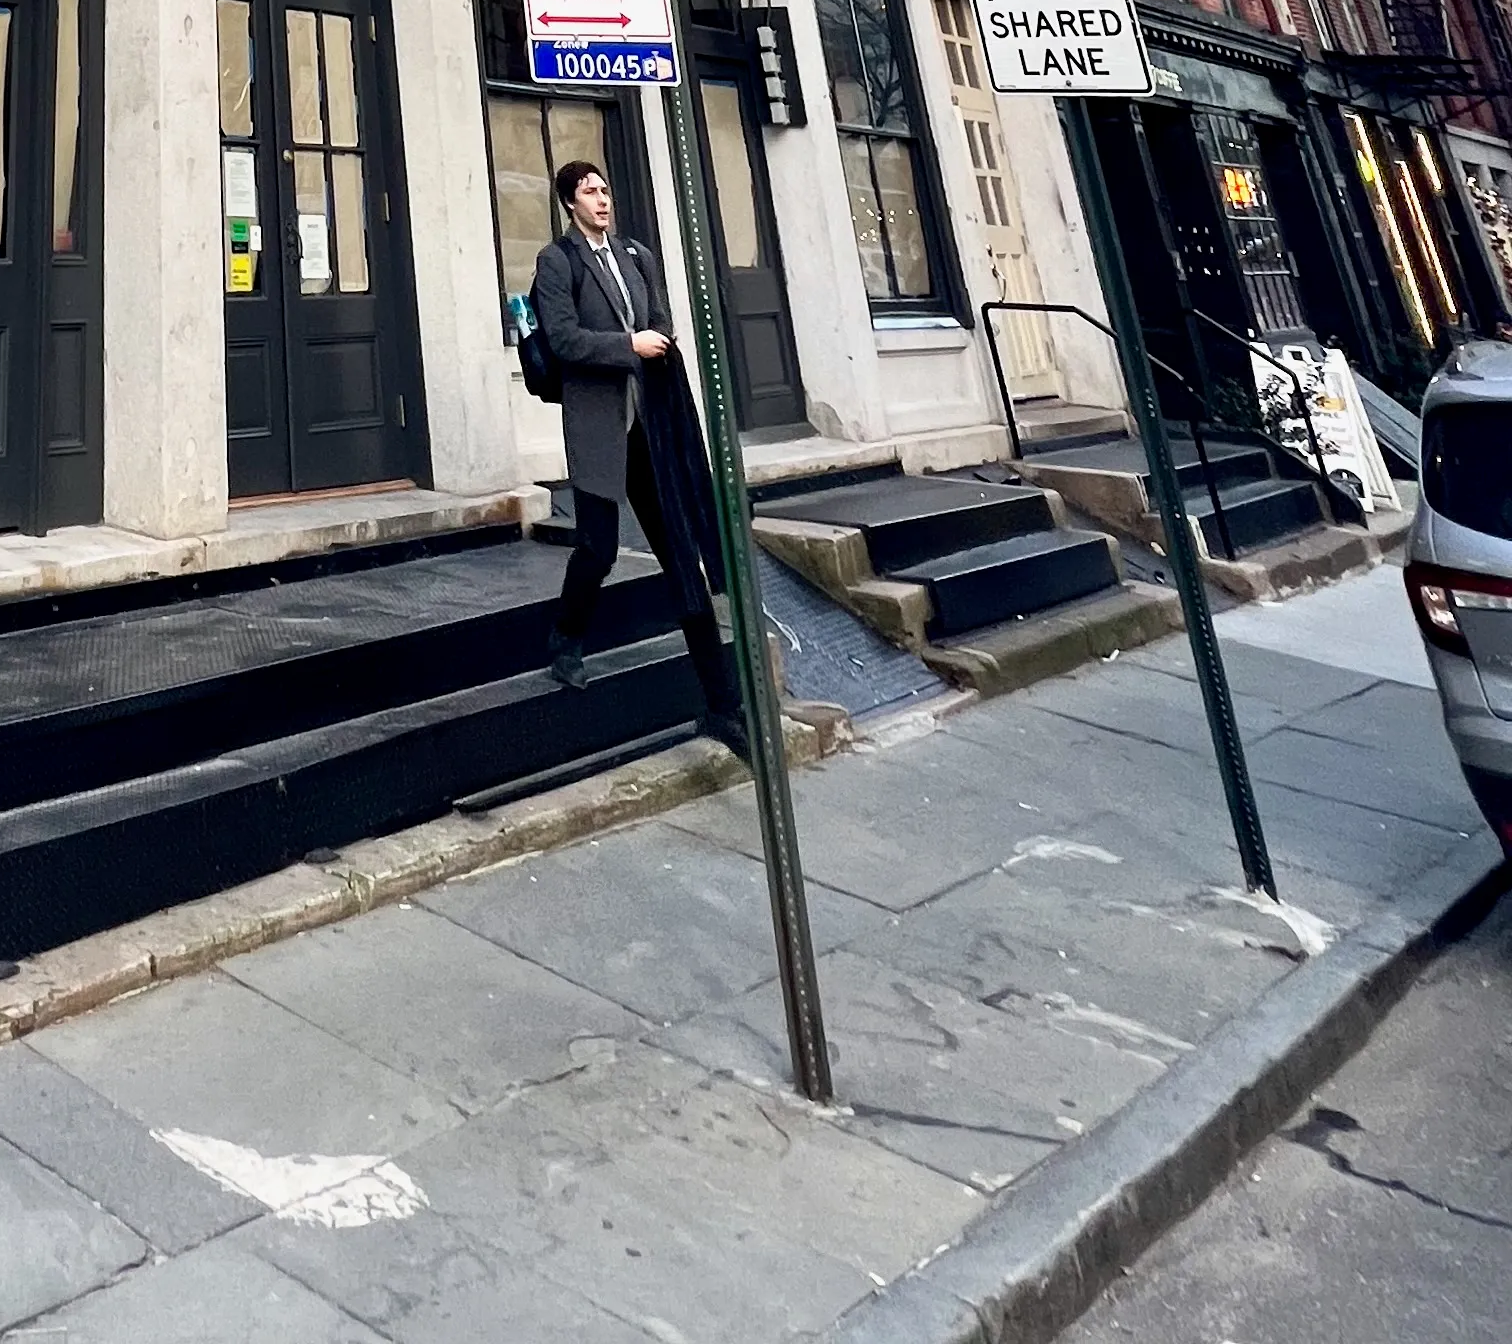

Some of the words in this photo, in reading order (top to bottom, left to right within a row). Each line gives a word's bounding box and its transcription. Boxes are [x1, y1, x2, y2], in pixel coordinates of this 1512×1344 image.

[990, 9, 1122, 39] SHARED
[555, 53, 642, 80] 100045
[1018, 48, 1110, 76] LANE
